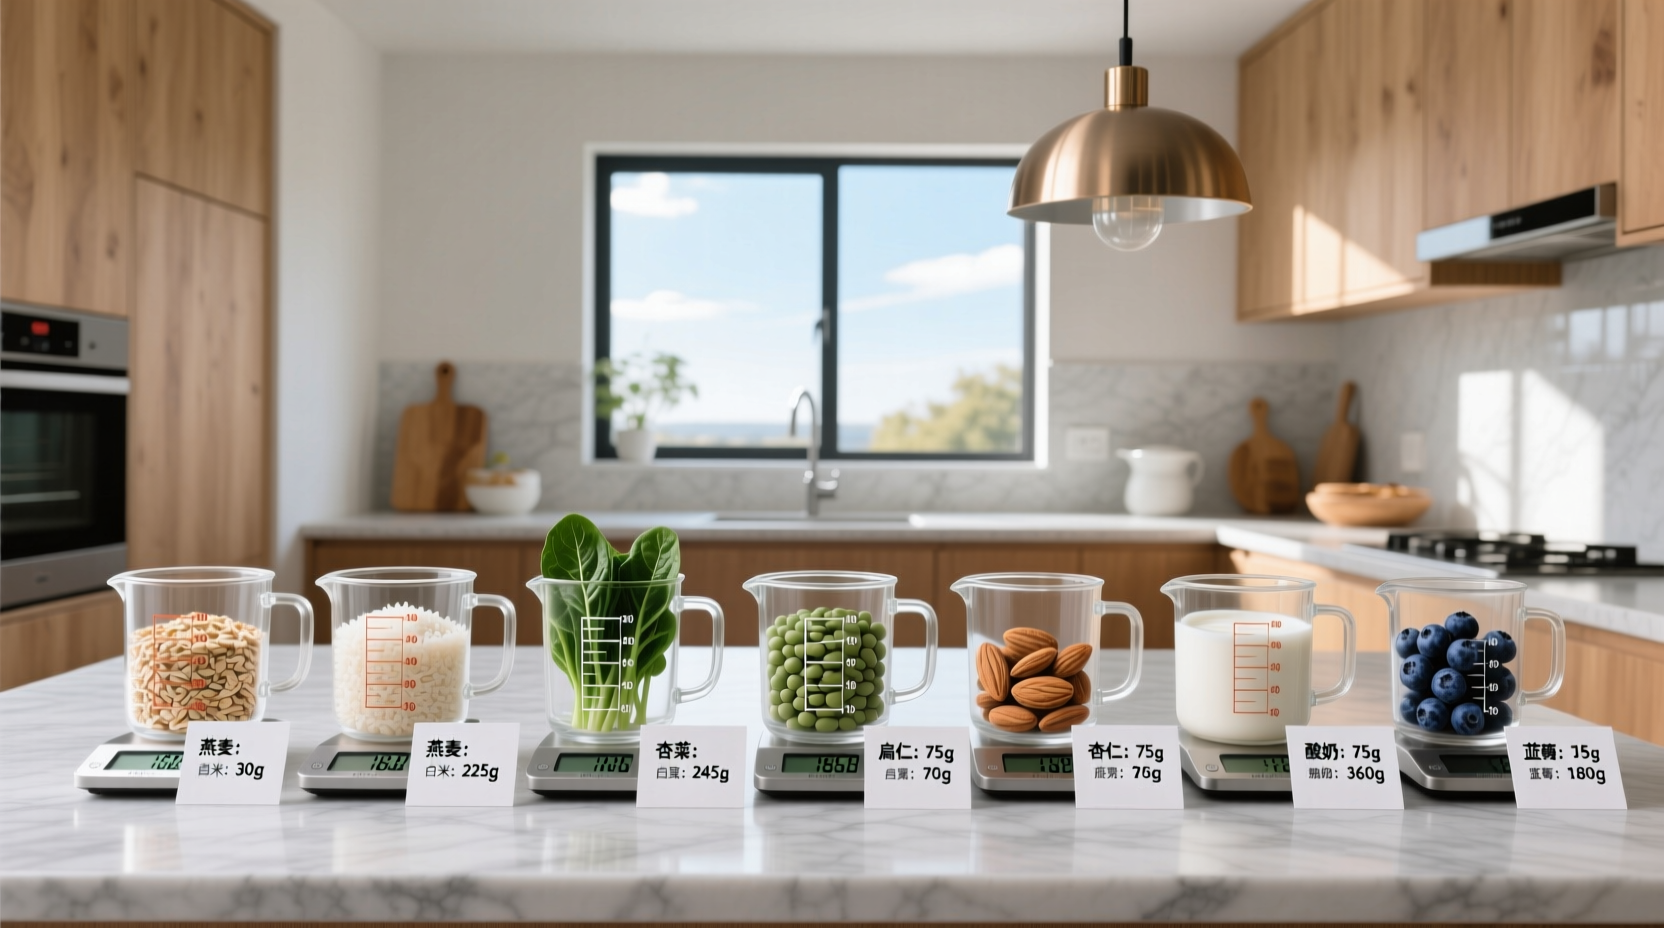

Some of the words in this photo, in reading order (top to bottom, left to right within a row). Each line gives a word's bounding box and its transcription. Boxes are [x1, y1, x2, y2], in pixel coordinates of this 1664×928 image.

[1488, 707, 1498, 715] 10
[925, 745, 954, 763] 75g
[1136, 744, 1164, 762] 75g
[1352, 745, 1381, 763] 75g
[235, 762, 264, 780] 30g
[462, 764, 499, 782] 225g
[692, 765, 729, 783] 245g
[923, 767, 951, 784] 70g
[1347, 766, 1385, 784] 360g
[1567, 767, 1606, 785] 180g
